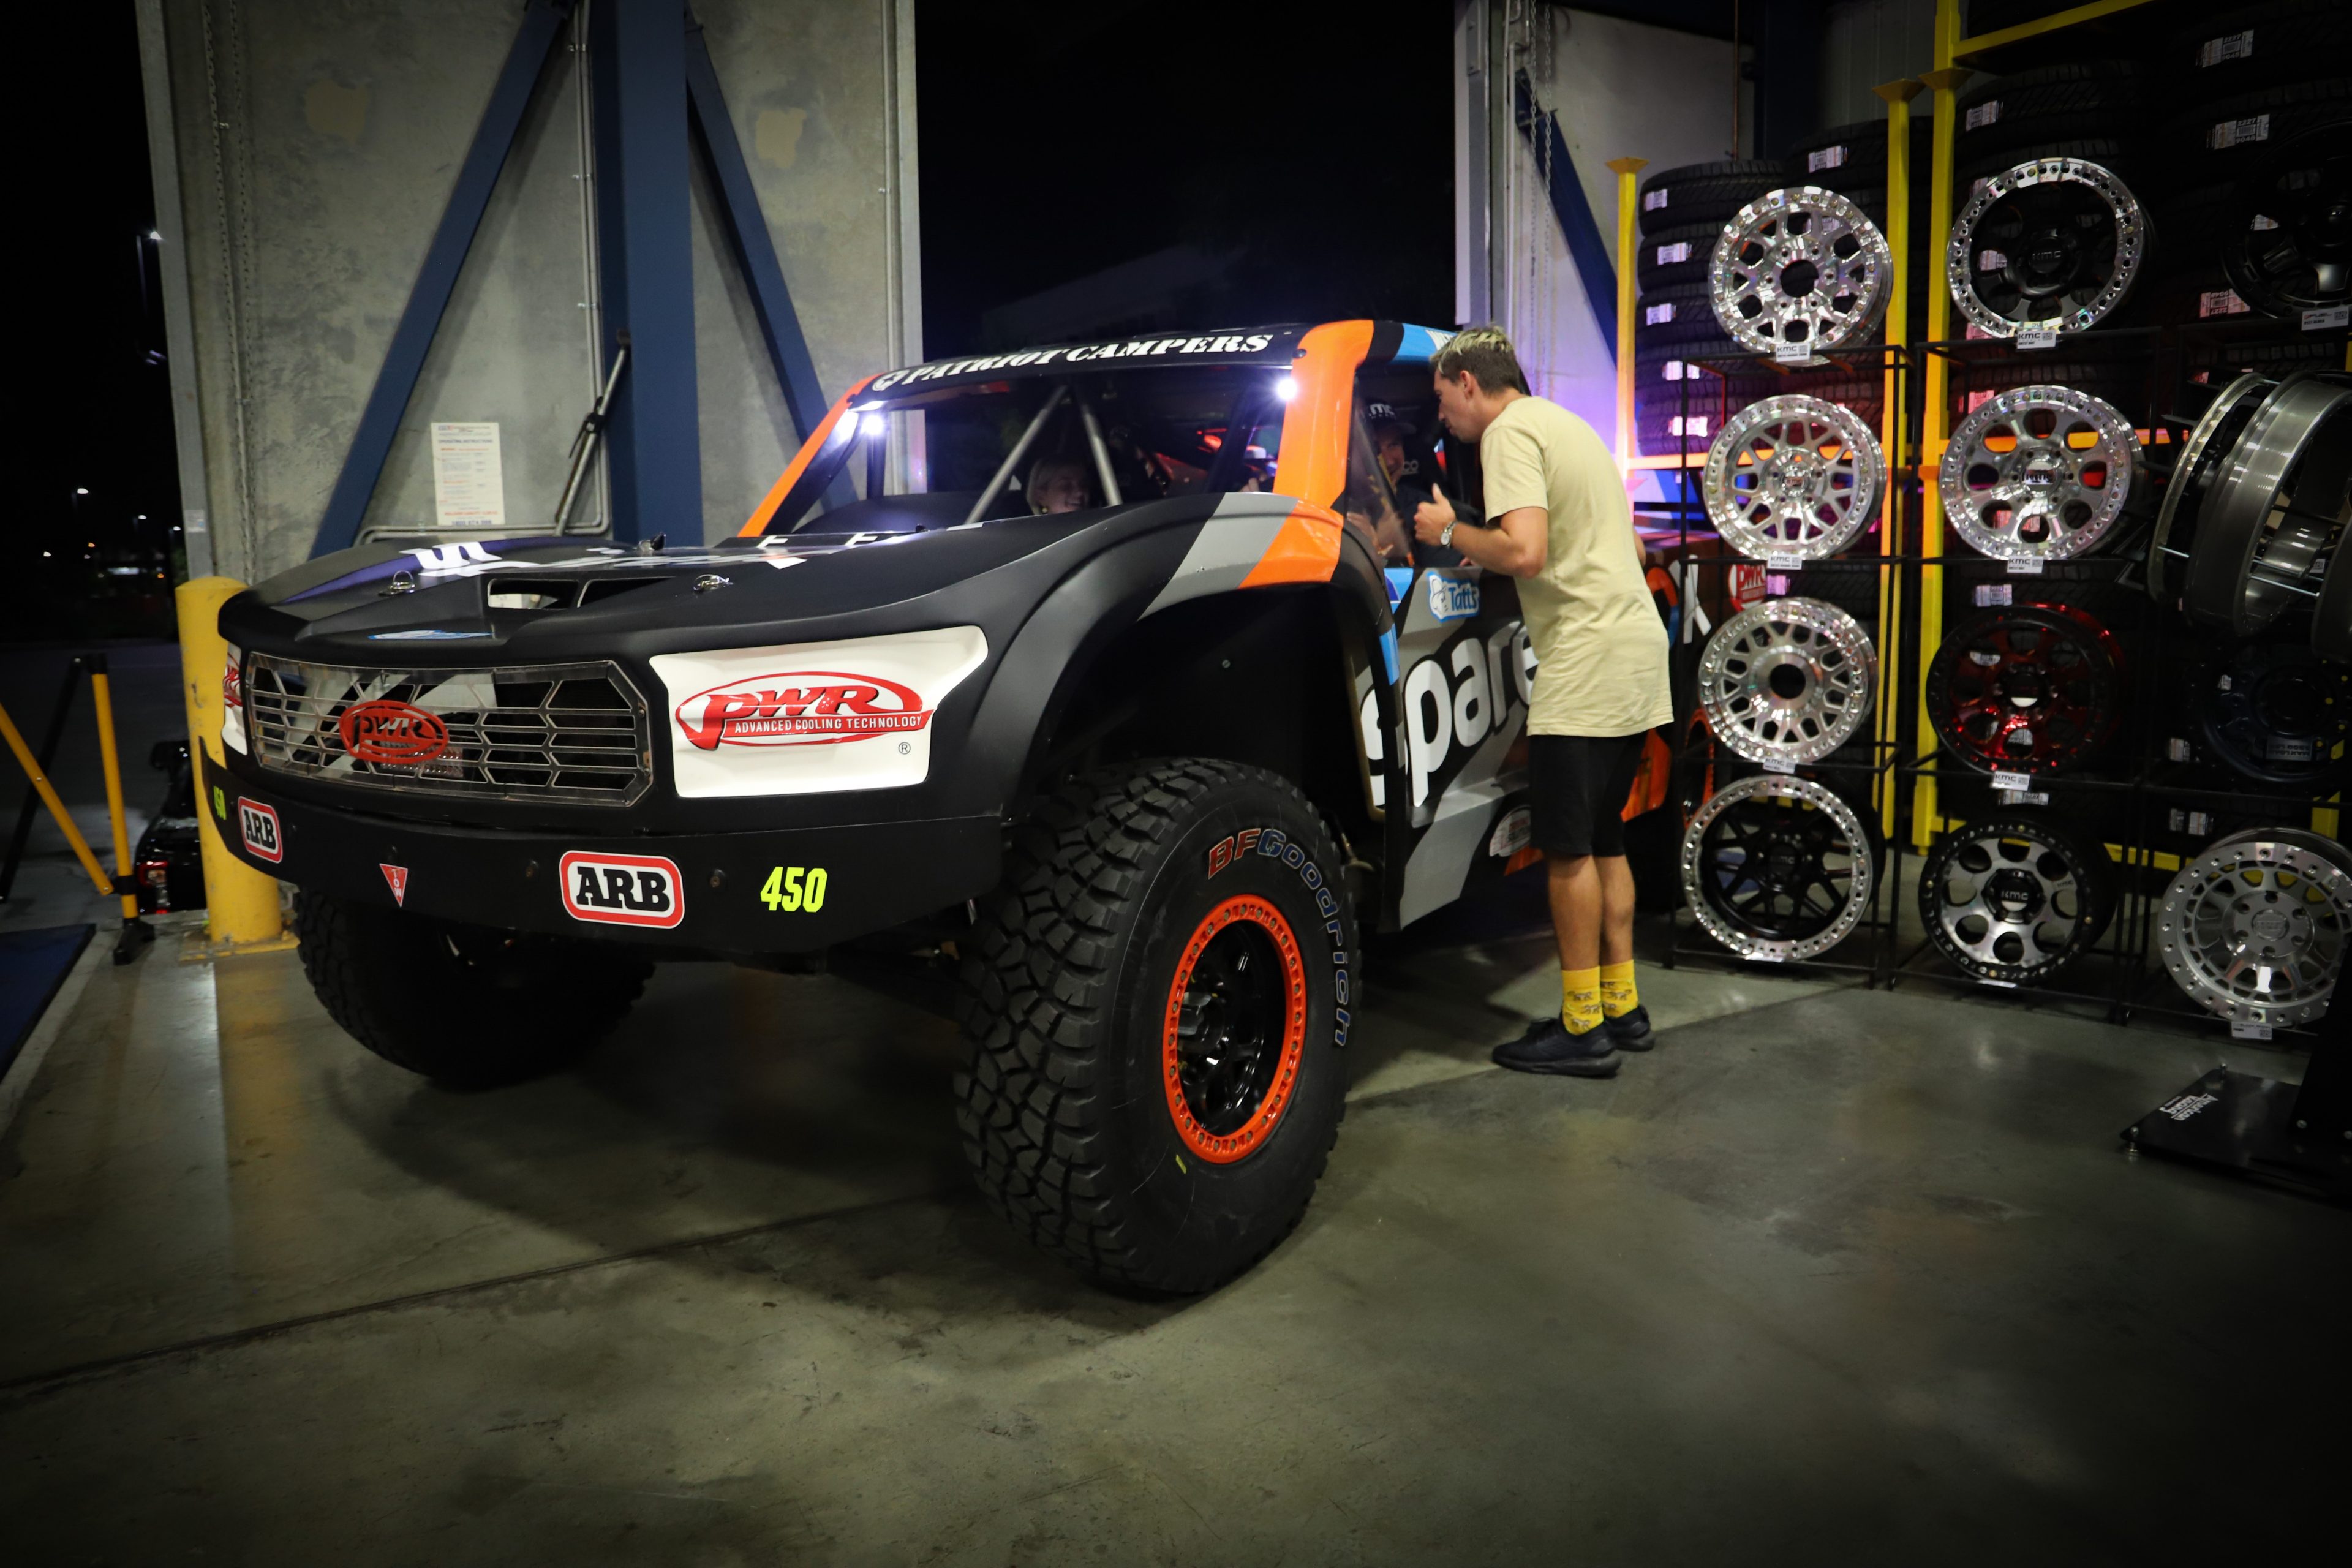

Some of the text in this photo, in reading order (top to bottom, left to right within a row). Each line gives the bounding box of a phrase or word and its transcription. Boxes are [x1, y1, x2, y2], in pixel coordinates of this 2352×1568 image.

[2237, 118, 2256, 126] 2227
[901, 334, 1273, 385] PATRIOT CAMPERS
[1448, 586, 1477, 612] Tatts
[352, 714, 435, 754] PWR
[685, 685, 880, 752] PWR
[735, 715, 922, 733] ADVANCED COOLING TECHNOLOGY
[243, 809, 277, 850] ARB
[576, 865, 671, 912] ARB
[760, 866, 828, 913] 450
[2000, 890, 2029, 900] KMC
[1207, 827, 1351, 1047] BFGoodrich
